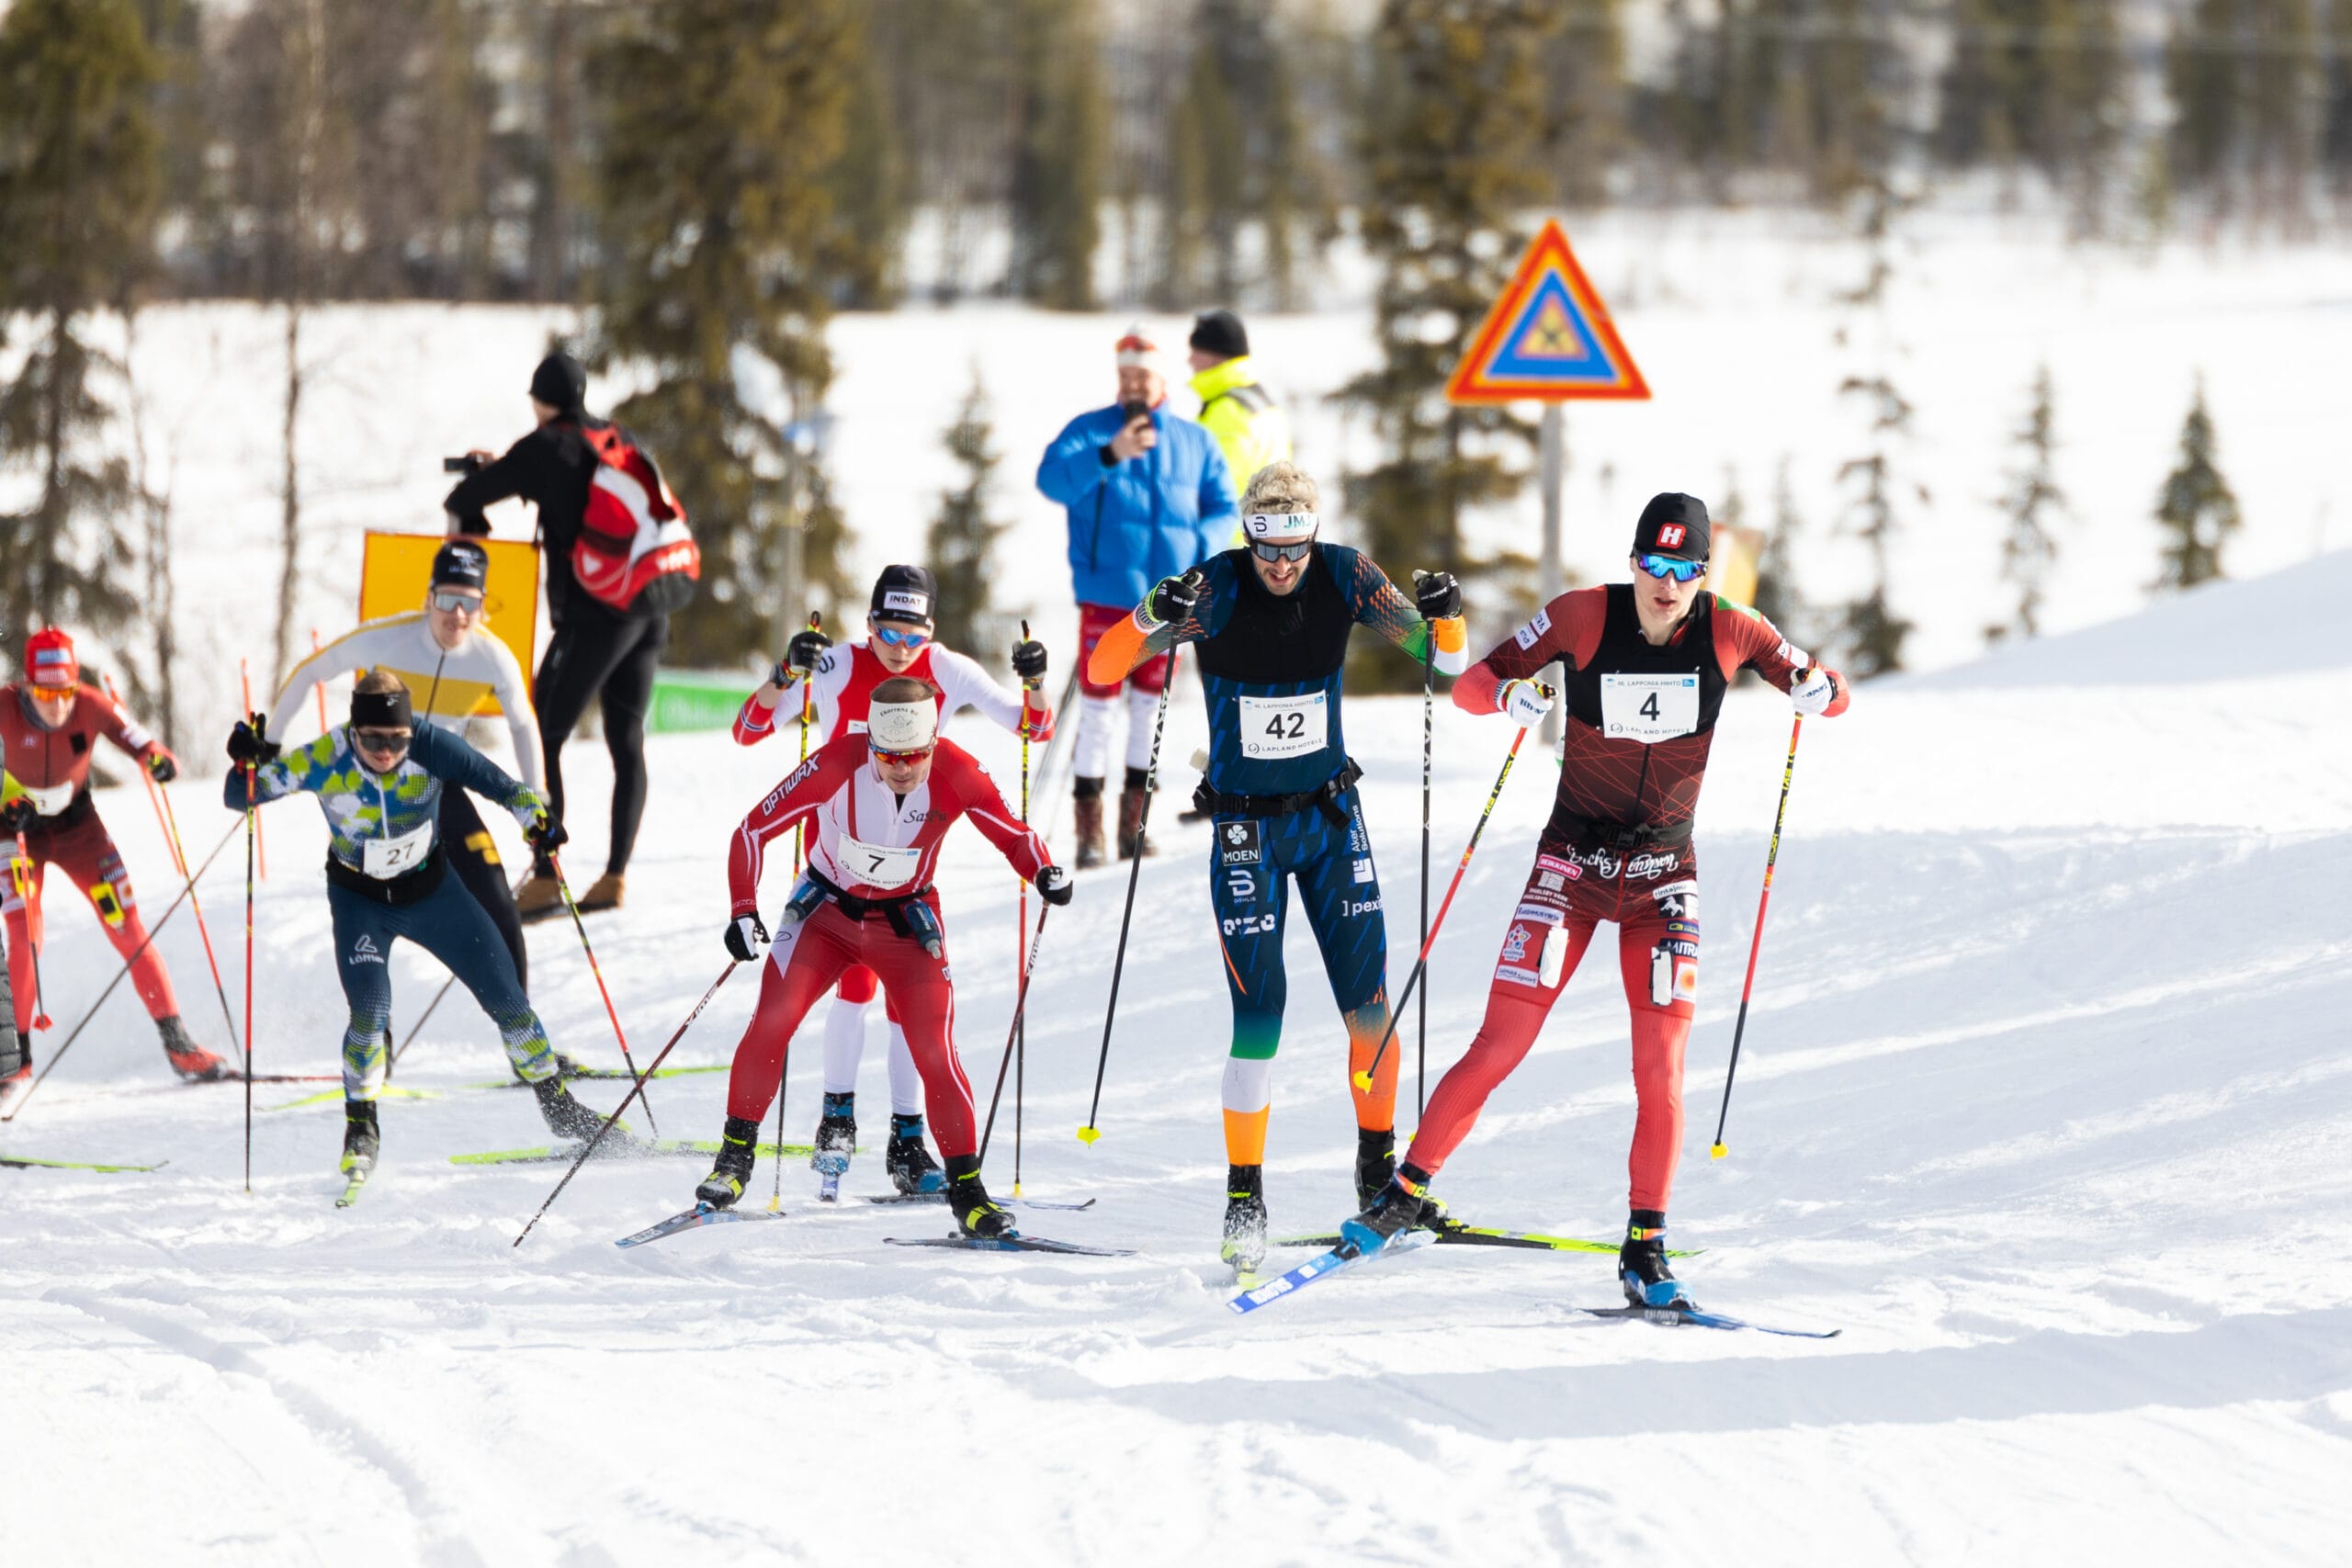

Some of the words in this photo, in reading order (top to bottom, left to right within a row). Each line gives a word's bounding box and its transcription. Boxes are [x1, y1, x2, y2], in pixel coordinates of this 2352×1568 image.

[1660, 526, 1682, 545] H
[1639, 692, 1660, 721] 4
[1265, 712, 1305, 739] 42
[1297, 738, 1322, 748] HOTELS
[762, 752, 820, 817] OPTIWAX
[1350, 829, 1361, 852] Aker
[1352, 805, 1368, 852] Solutions
[387, 841, 414, 866] 27
[868, 853, 886, 873] 7
[1224, 849, 1259, 863] MOEN
